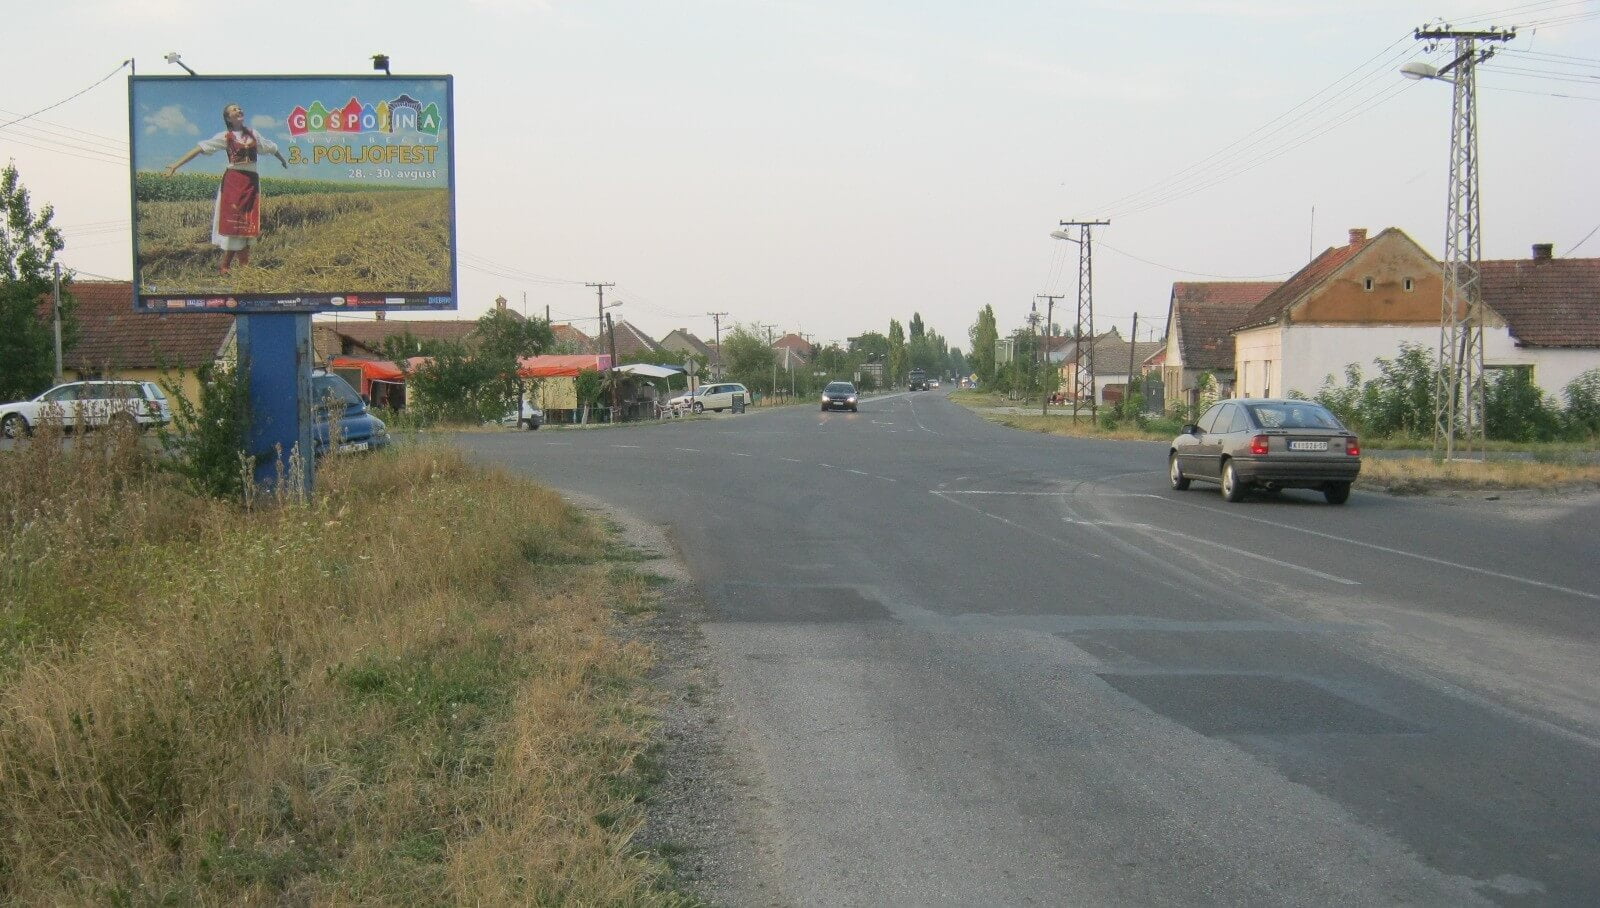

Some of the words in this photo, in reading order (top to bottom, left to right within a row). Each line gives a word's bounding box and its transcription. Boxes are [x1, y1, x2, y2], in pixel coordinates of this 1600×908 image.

[288, 145, 309, 165] 3.
[313, 145, 439, 165] POLJOFEST
[348, 169, 366, 178] 28.
[377, 169, 394, 178] 30.
[397, 169, 437, 180] avgust
